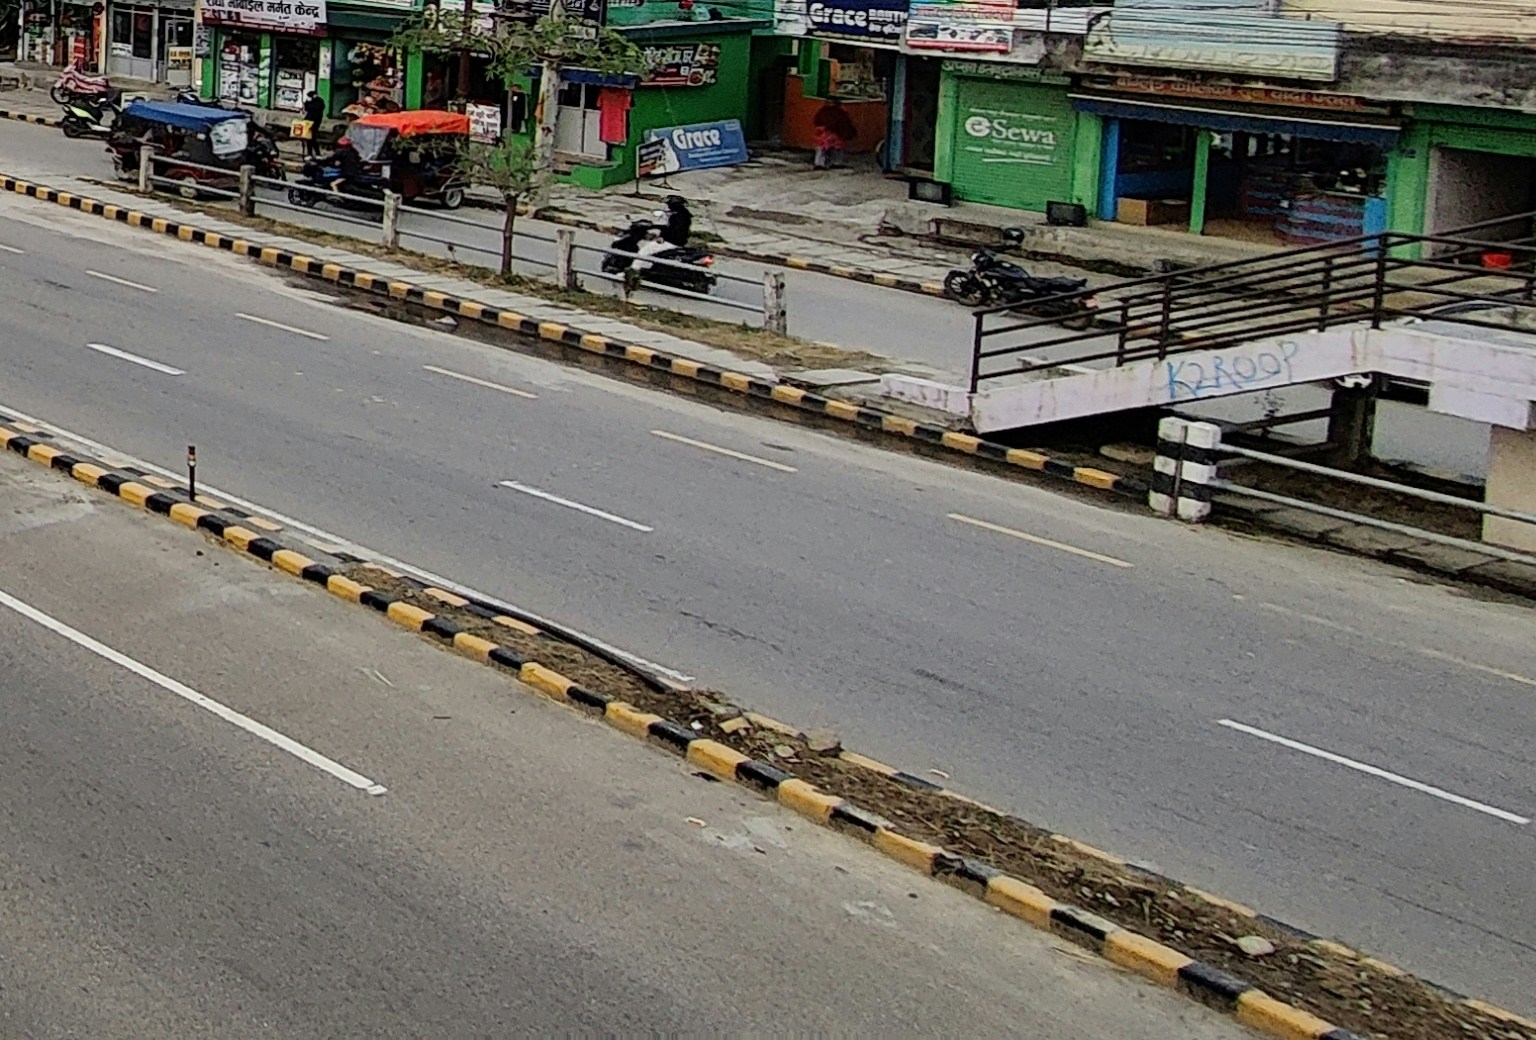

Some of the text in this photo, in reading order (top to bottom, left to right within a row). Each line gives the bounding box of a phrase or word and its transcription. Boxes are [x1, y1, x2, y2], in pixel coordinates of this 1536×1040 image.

[809, 2, 868, 27] Grace
[672, 128, 721, 150] Grace
[965, 116, 1057, 145] eSewa
